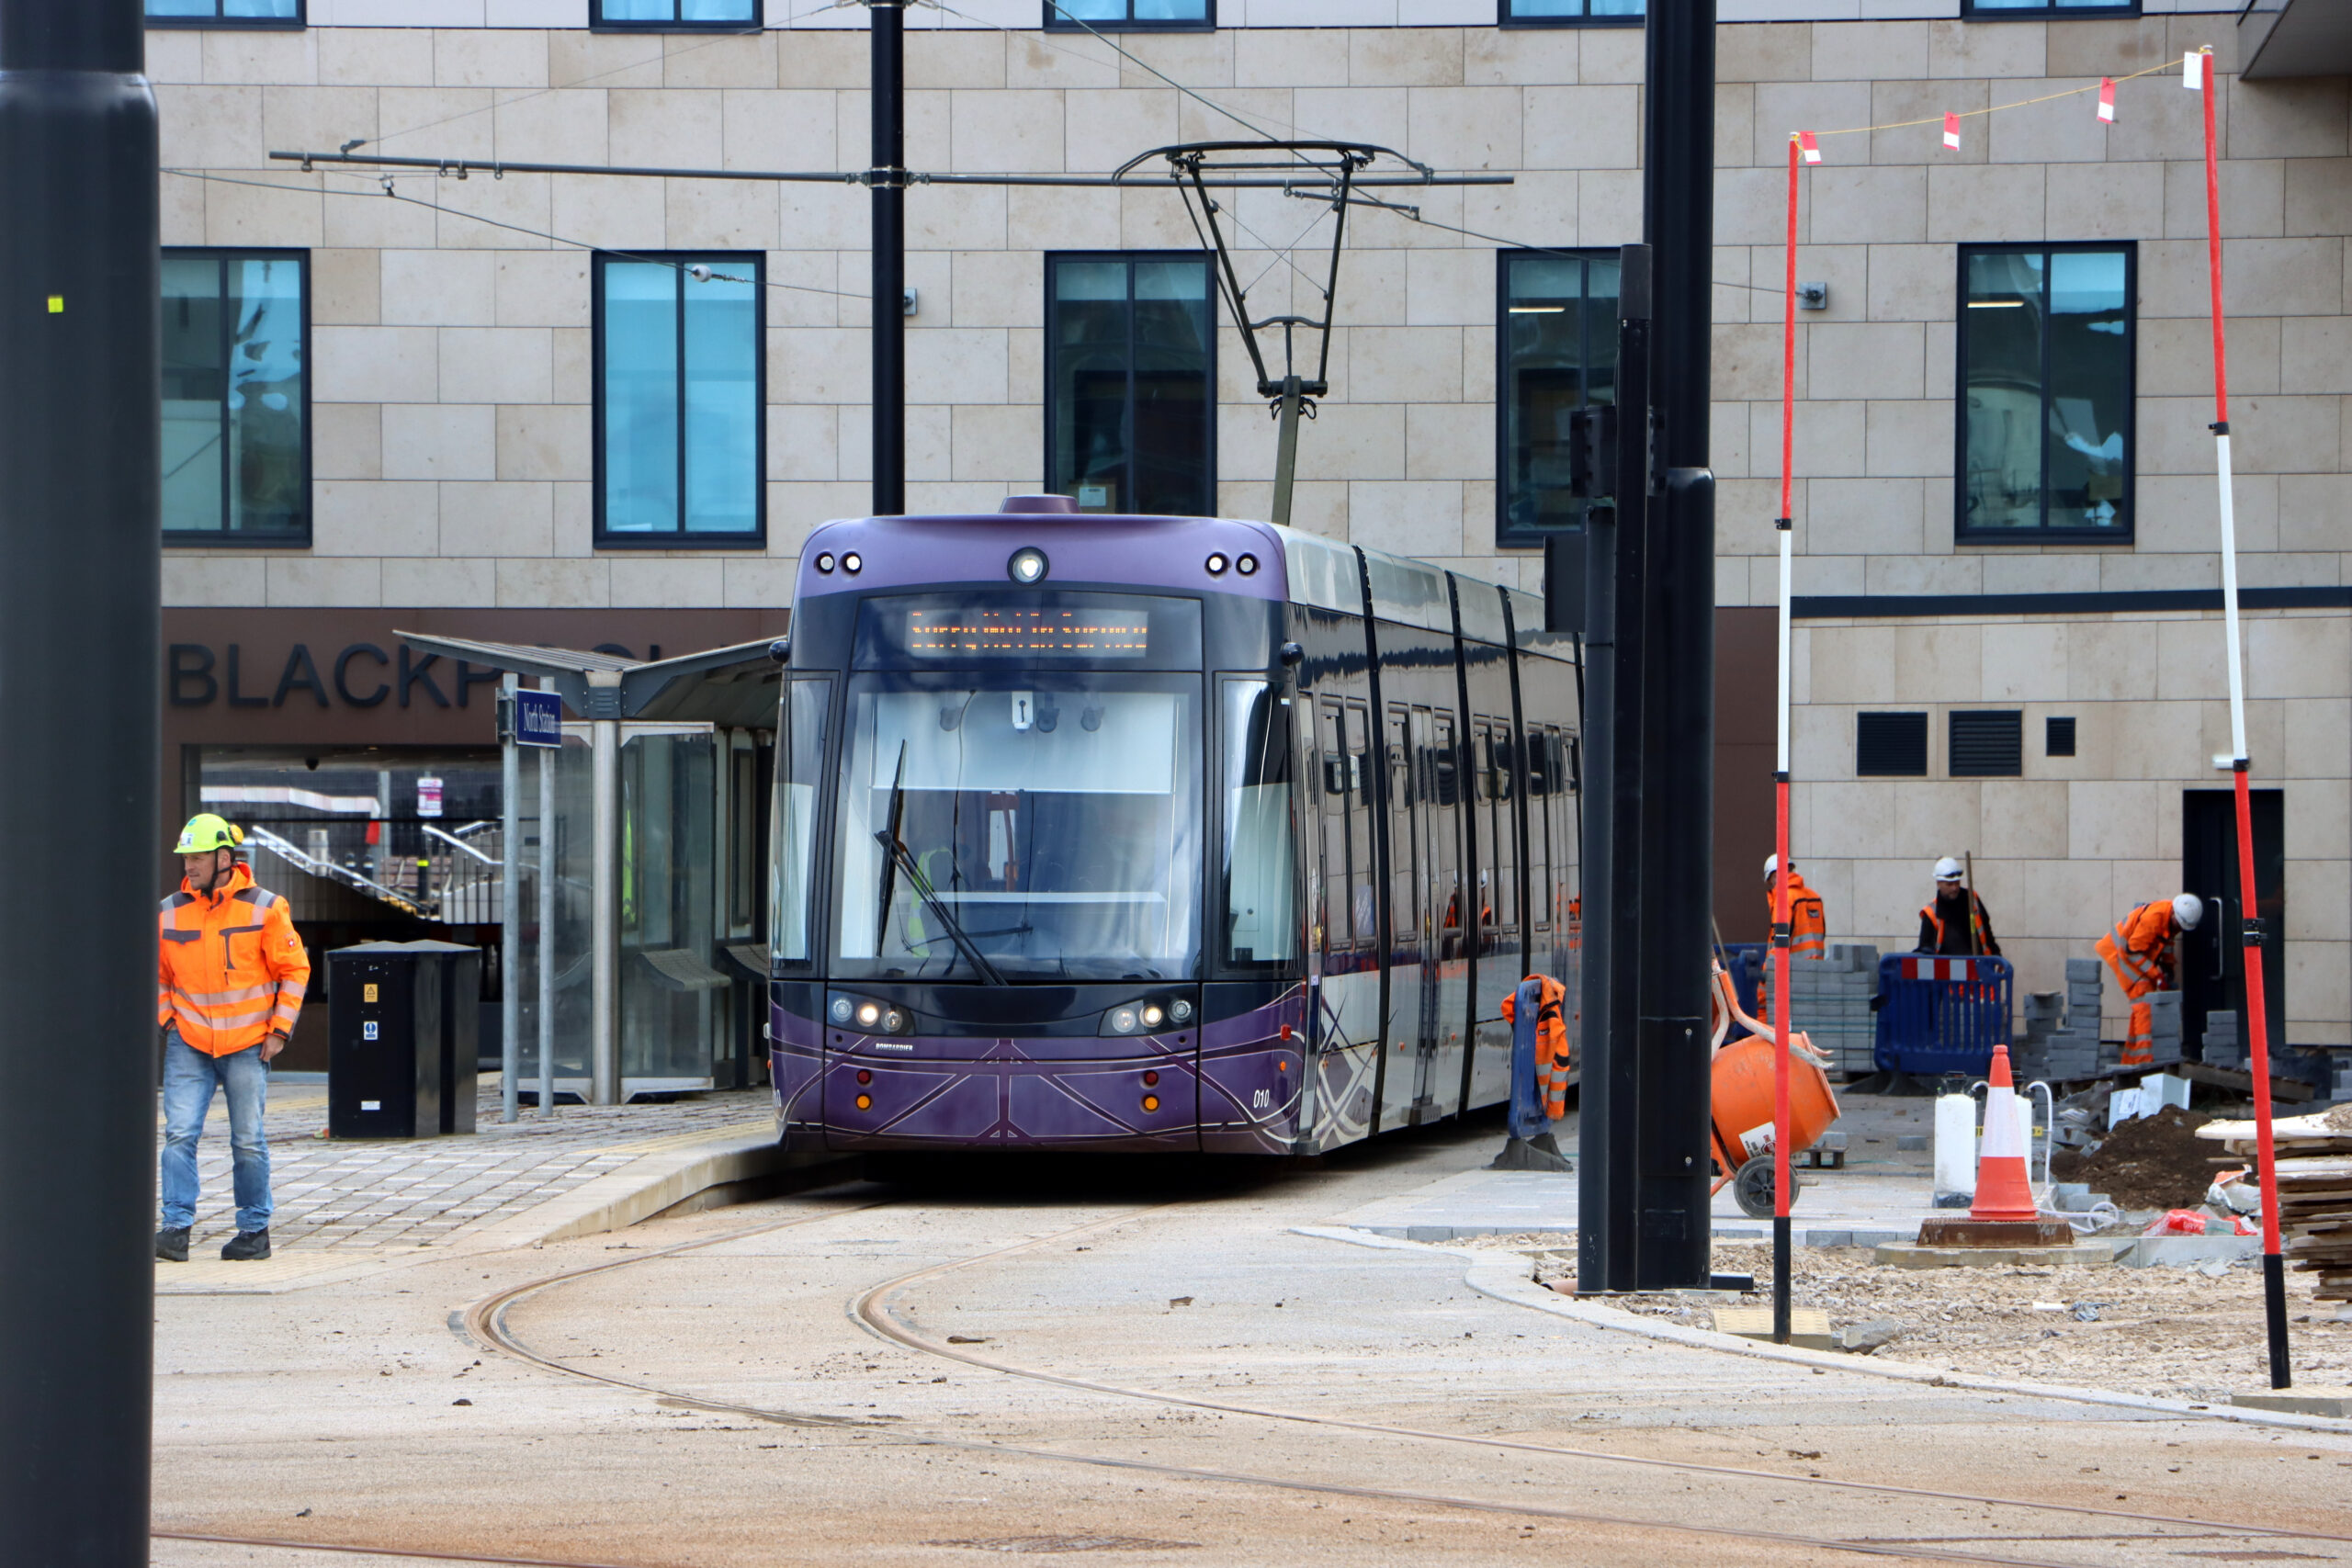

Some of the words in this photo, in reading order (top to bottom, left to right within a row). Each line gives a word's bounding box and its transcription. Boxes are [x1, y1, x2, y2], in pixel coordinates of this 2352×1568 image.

[523, 702, 538, 732] North
[875, 1043, 913, 1051] BOMBARDIER
[1253, 1089, 1270, 1109] 010
